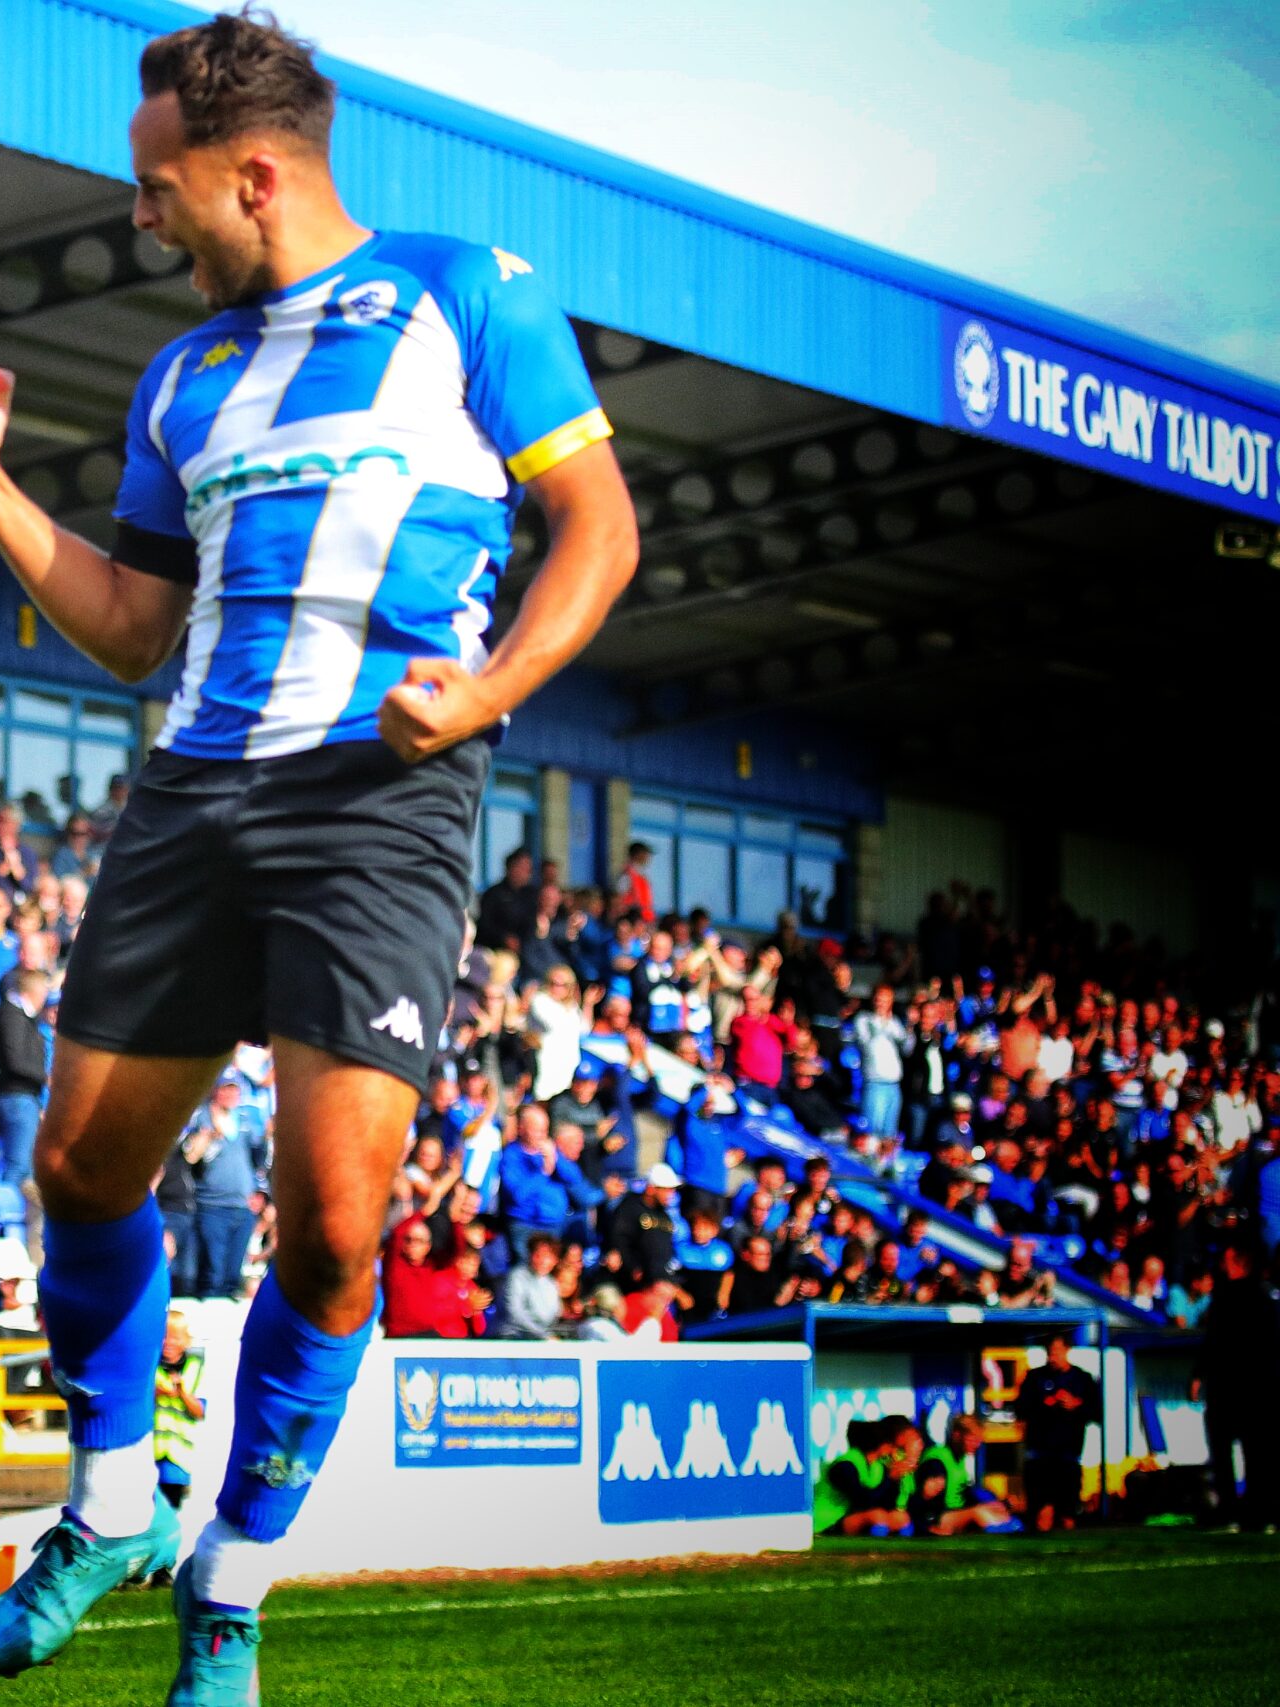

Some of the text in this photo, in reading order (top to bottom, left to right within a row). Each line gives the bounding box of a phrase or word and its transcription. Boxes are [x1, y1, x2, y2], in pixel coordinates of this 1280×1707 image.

[1002, 347, 1070, 437] THE
[1073, 372, 1159, 464] GARY
[1161, 399, 1272, 500] TALBOT
